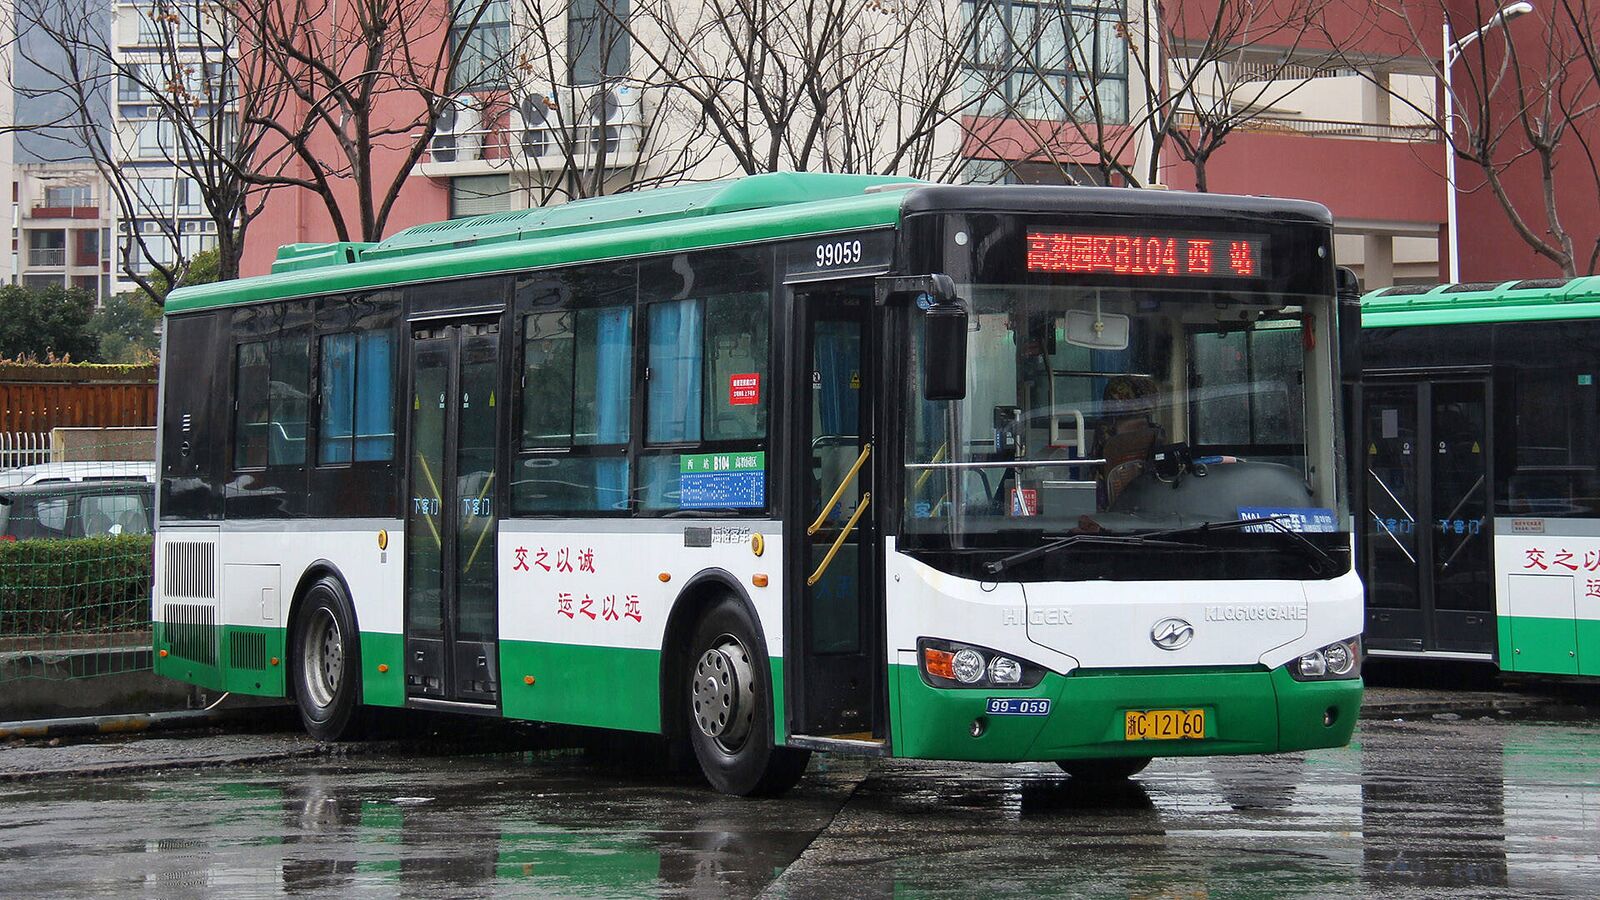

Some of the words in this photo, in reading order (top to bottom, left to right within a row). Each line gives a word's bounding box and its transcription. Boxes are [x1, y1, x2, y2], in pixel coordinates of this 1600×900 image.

[816, 240, 861, 267] 99059
[713, 456, 730, 471] B104
[413, 496, 439, 516] 下客门
[463, 496, 490, 516] 下客门
[513, 546, 596, 574] 交之以诚
[557, 592, 643, 623] 运之以远
[1002, 607, 1073, 626] HIGER
[1204, 605, 1308, 622] KLQ6109GAHE
[991, 701, 1047, 714] 99-059
